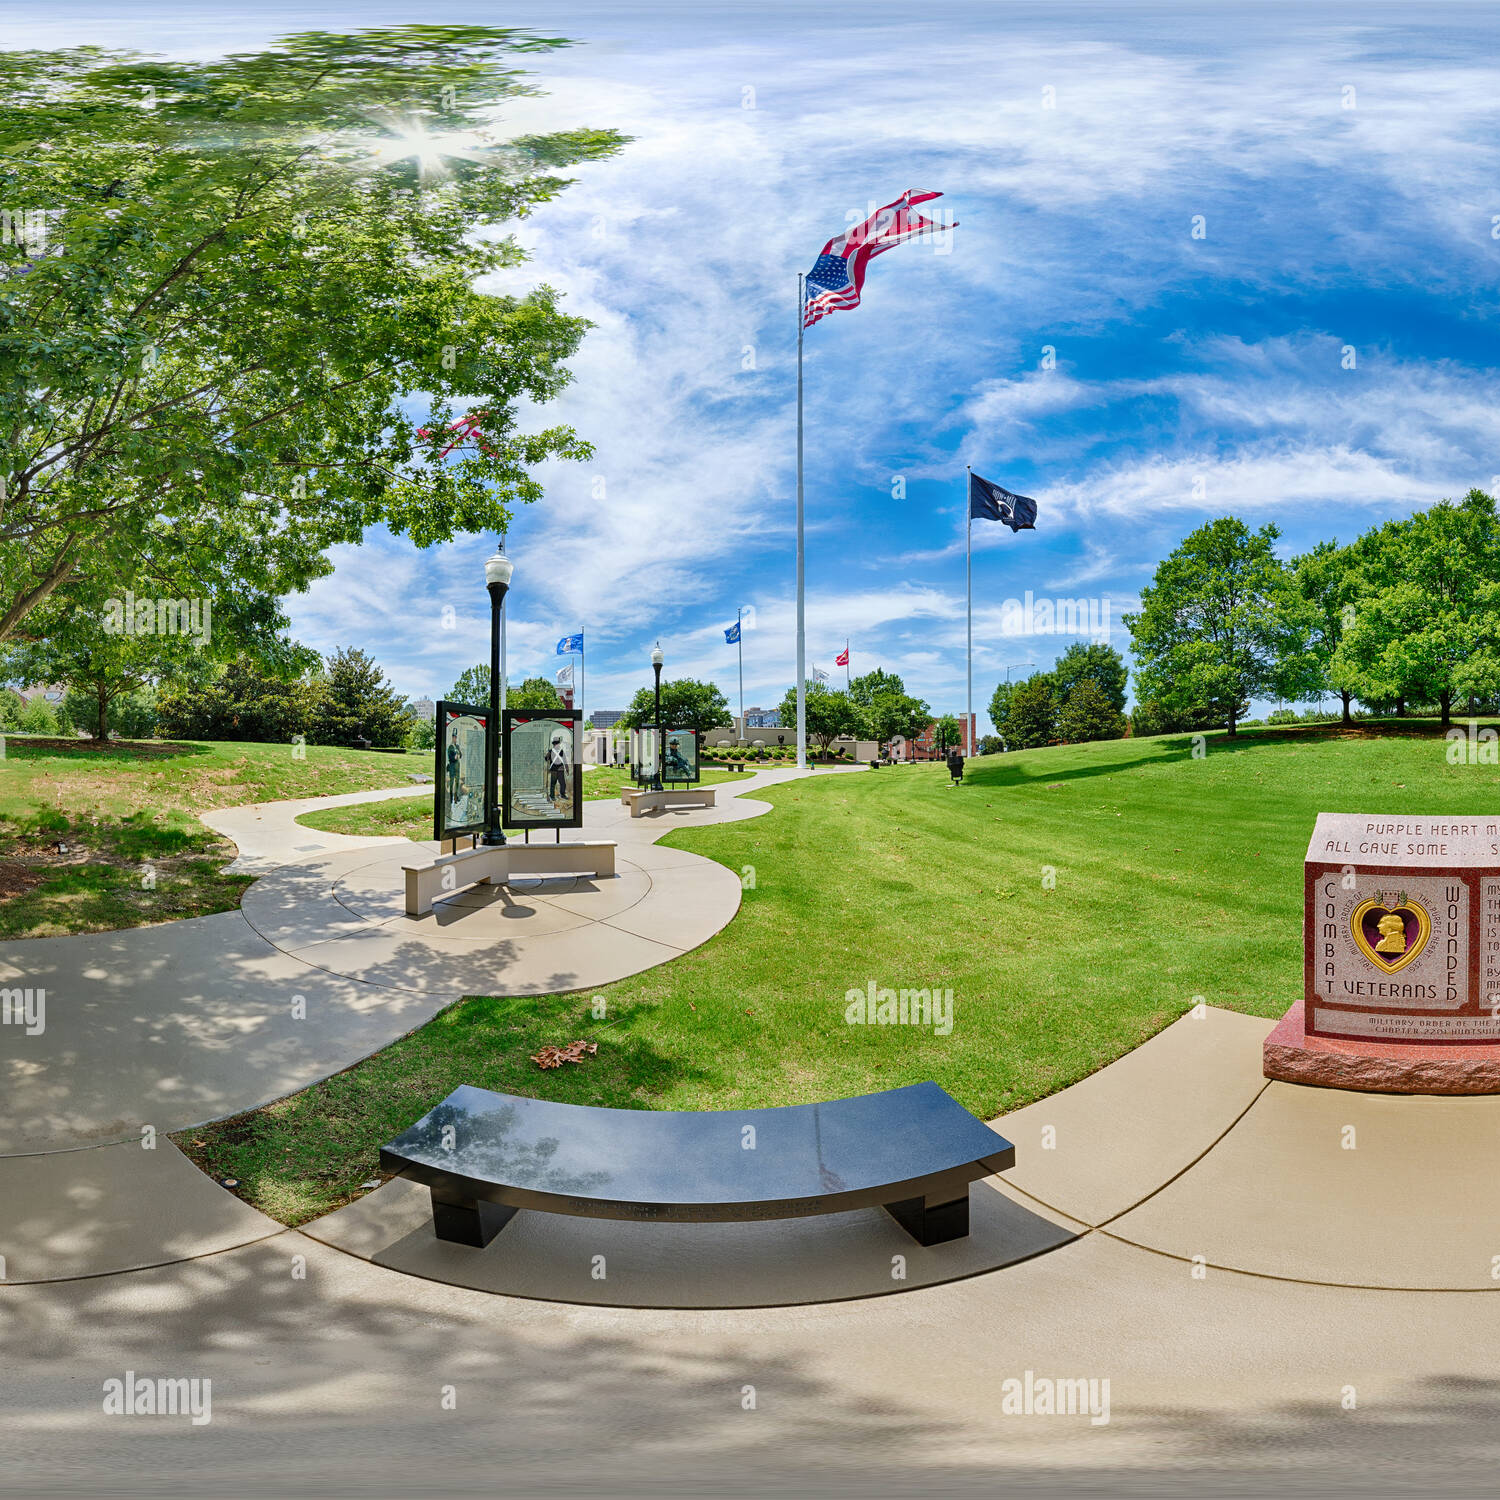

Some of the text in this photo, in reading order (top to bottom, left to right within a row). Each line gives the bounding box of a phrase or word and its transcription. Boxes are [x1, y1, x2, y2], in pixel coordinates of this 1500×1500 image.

[1366, 824, 1422, 835] PURPLE
[1431, 825, 1478, 836] HEART
[1325, 841, 1350, 852] ALL
[1359, 842, 1398, 854] GAVE
[1407, 843, 1448, 856] SOME
[1430, 907, 1442, 934] PURPLE
[1324, 882, 1337, 993] COMBAT
[1487, 928, 1496, 937] IS
[1446, 886, 1460, 1000] WOUNDED
[1487, 942, 1499, 951] TO
[1487, 954, 1496, 964] IF
[1344, 980, 1437, 999] VETERANS
[1369, 1017, 1414, 1026] MILITARY
